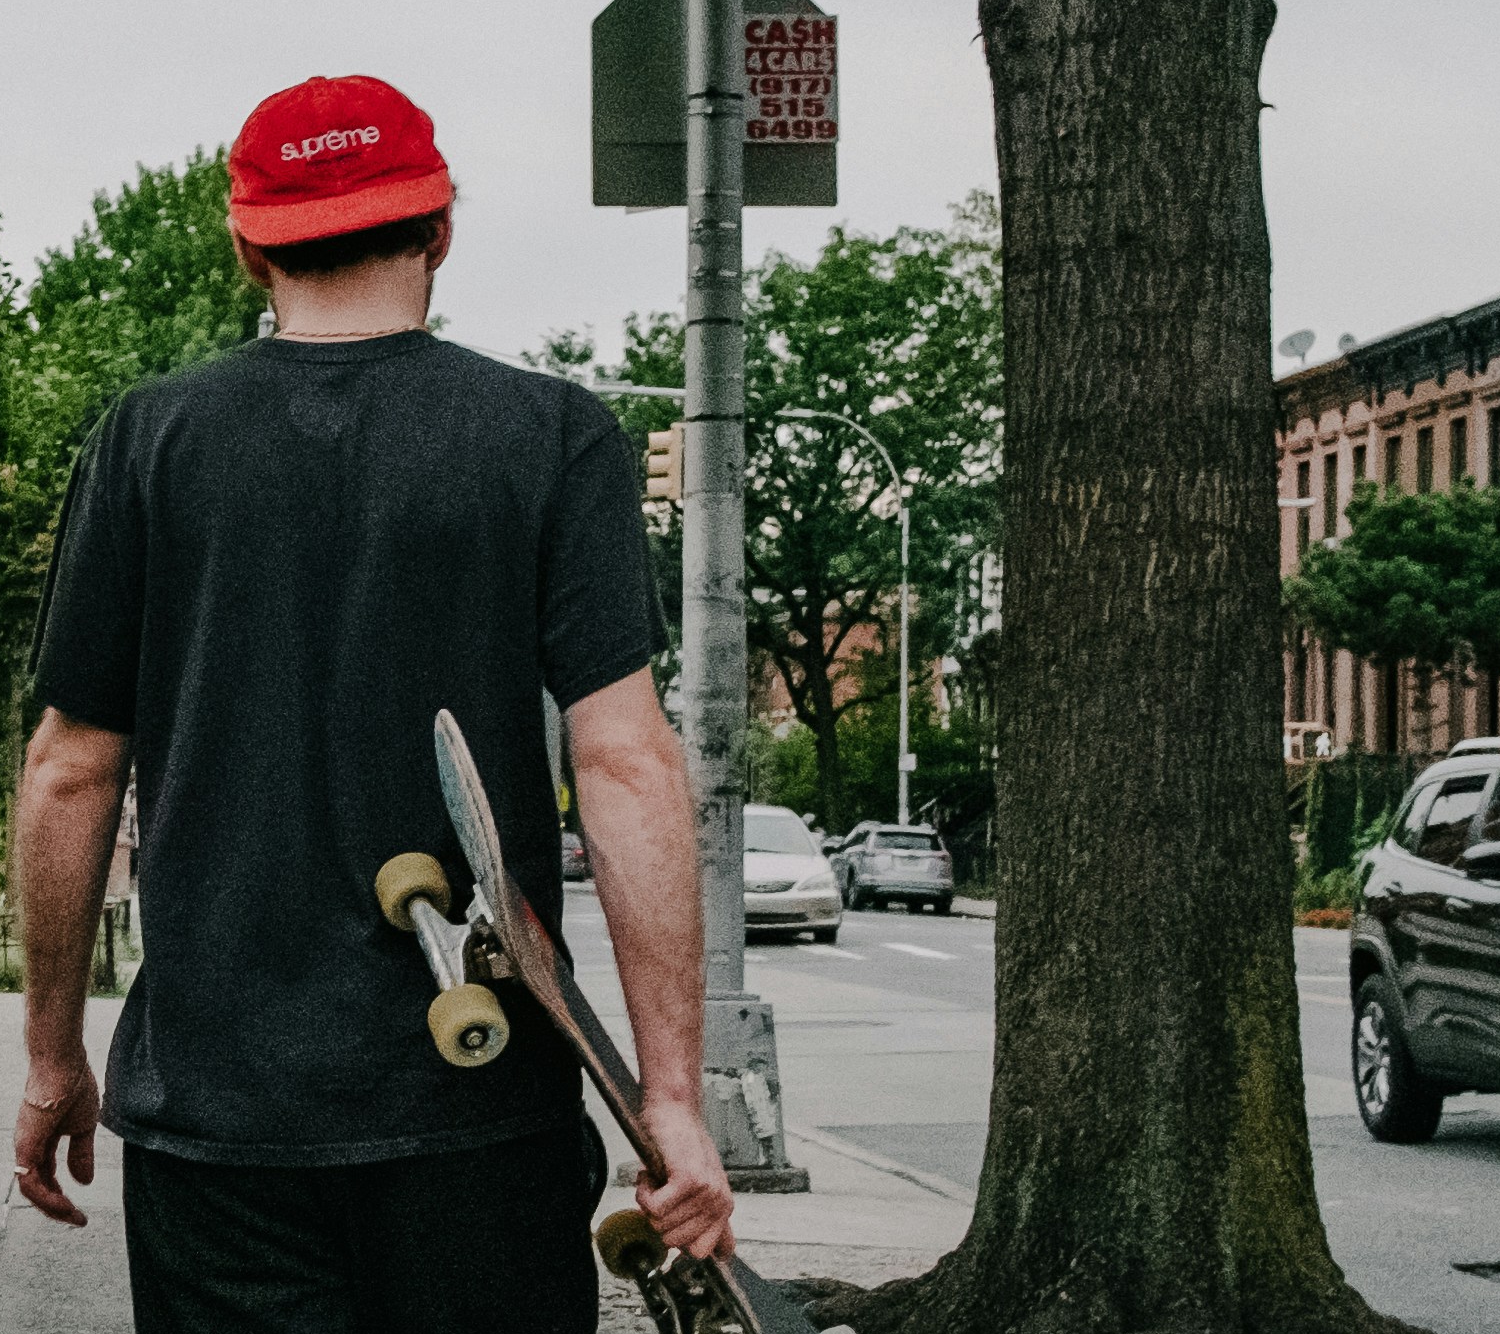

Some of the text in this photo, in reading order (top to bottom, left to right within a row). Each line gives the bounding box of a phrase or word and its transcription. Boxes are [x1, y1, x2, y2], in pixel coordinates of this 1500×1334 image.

[747, 52, 763, 72] 4
[750, 77, 831, 96] (917)
[760, 97, 824, 118] 515
[746, 119, 837, 139] 6499
[280, 124, 381, 162] supreme
